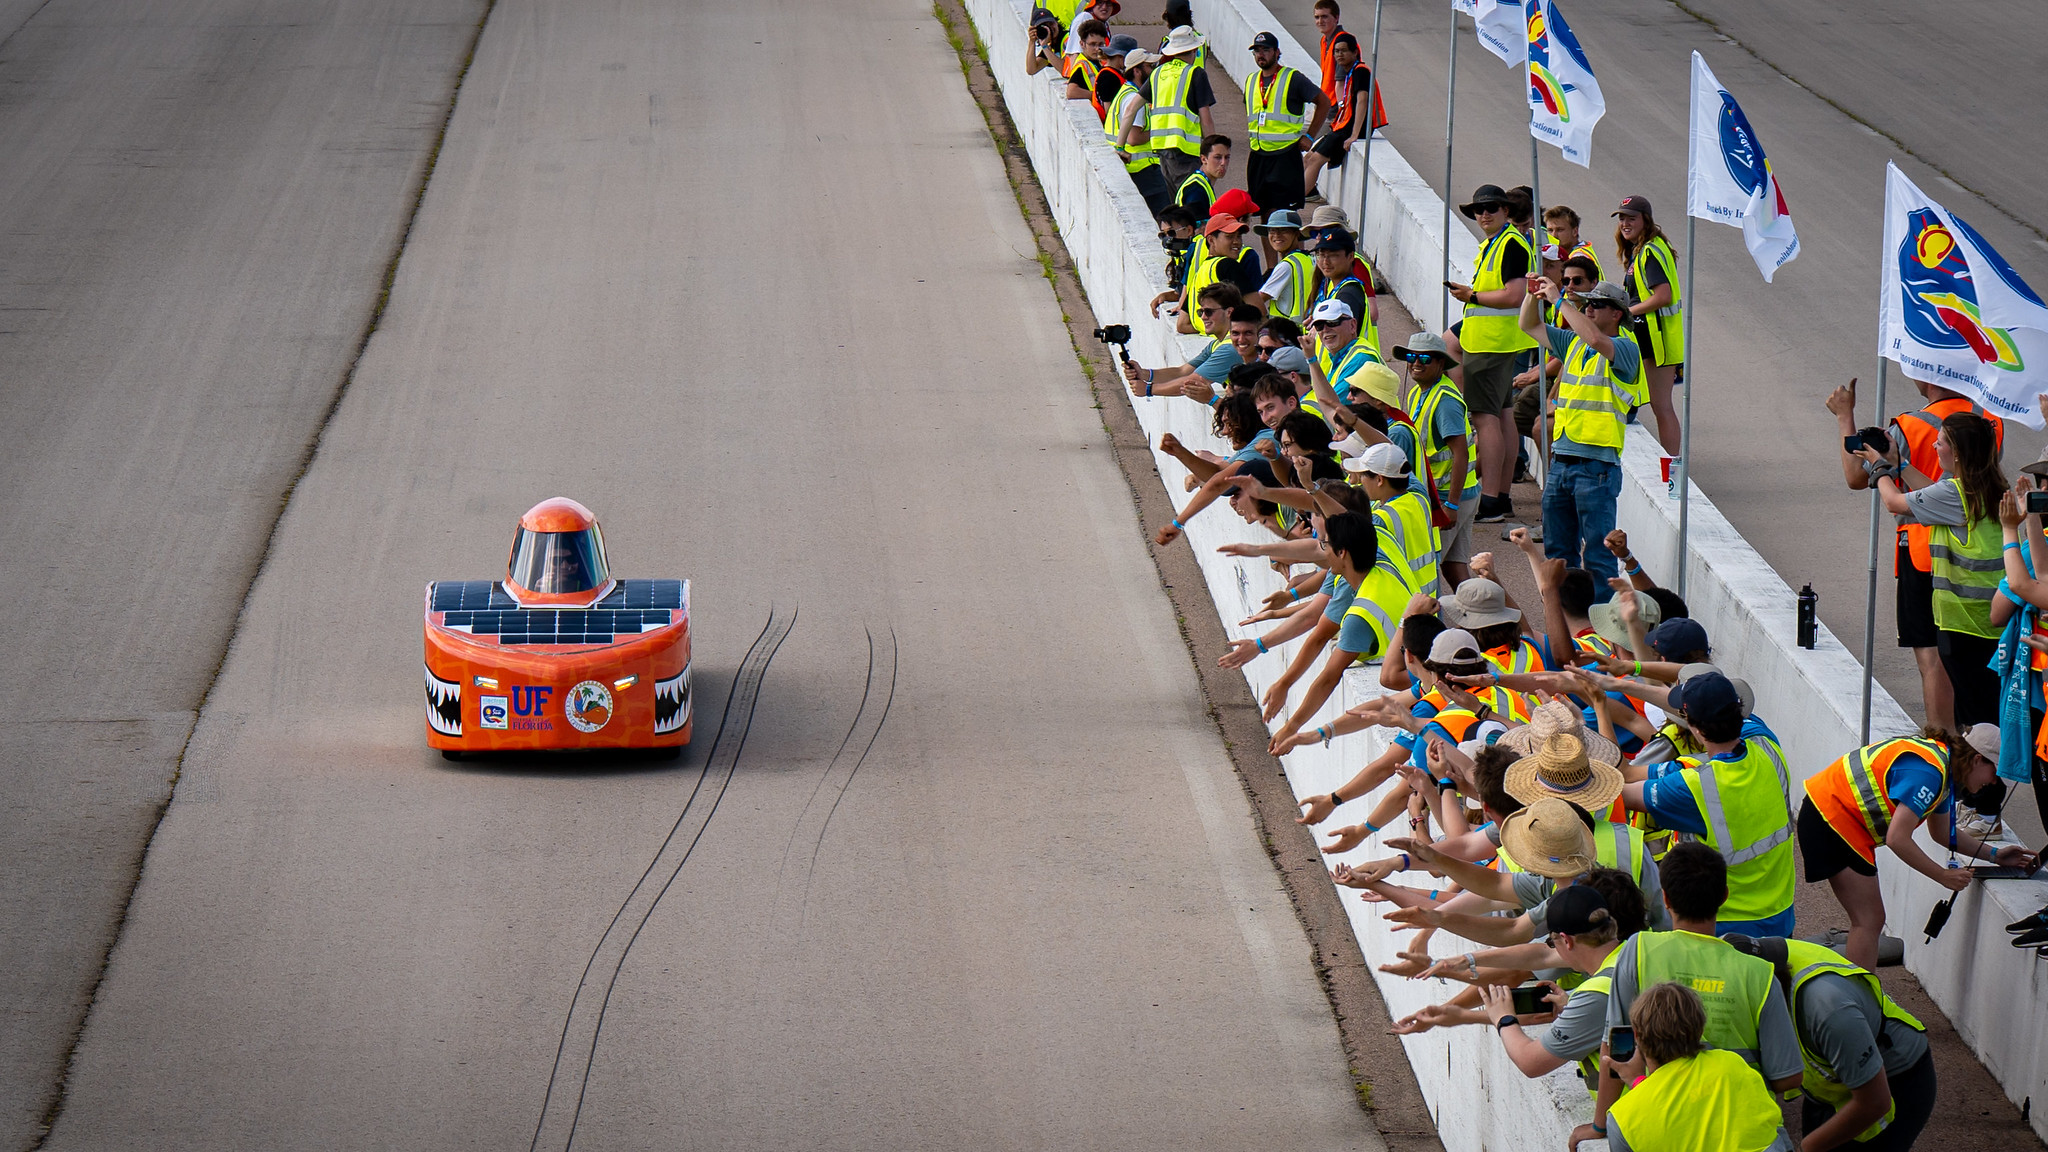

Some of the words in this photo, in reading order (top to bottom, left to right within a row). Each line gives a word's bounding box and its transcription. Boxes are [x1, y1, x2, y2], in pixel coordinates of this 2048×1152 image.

[1532, 121, 1560, 138] cational
[512, 685, 553, 716] UF
[512, 721, 553, 730] FLORIDA
[1917, 785, 1935, 804] 55
